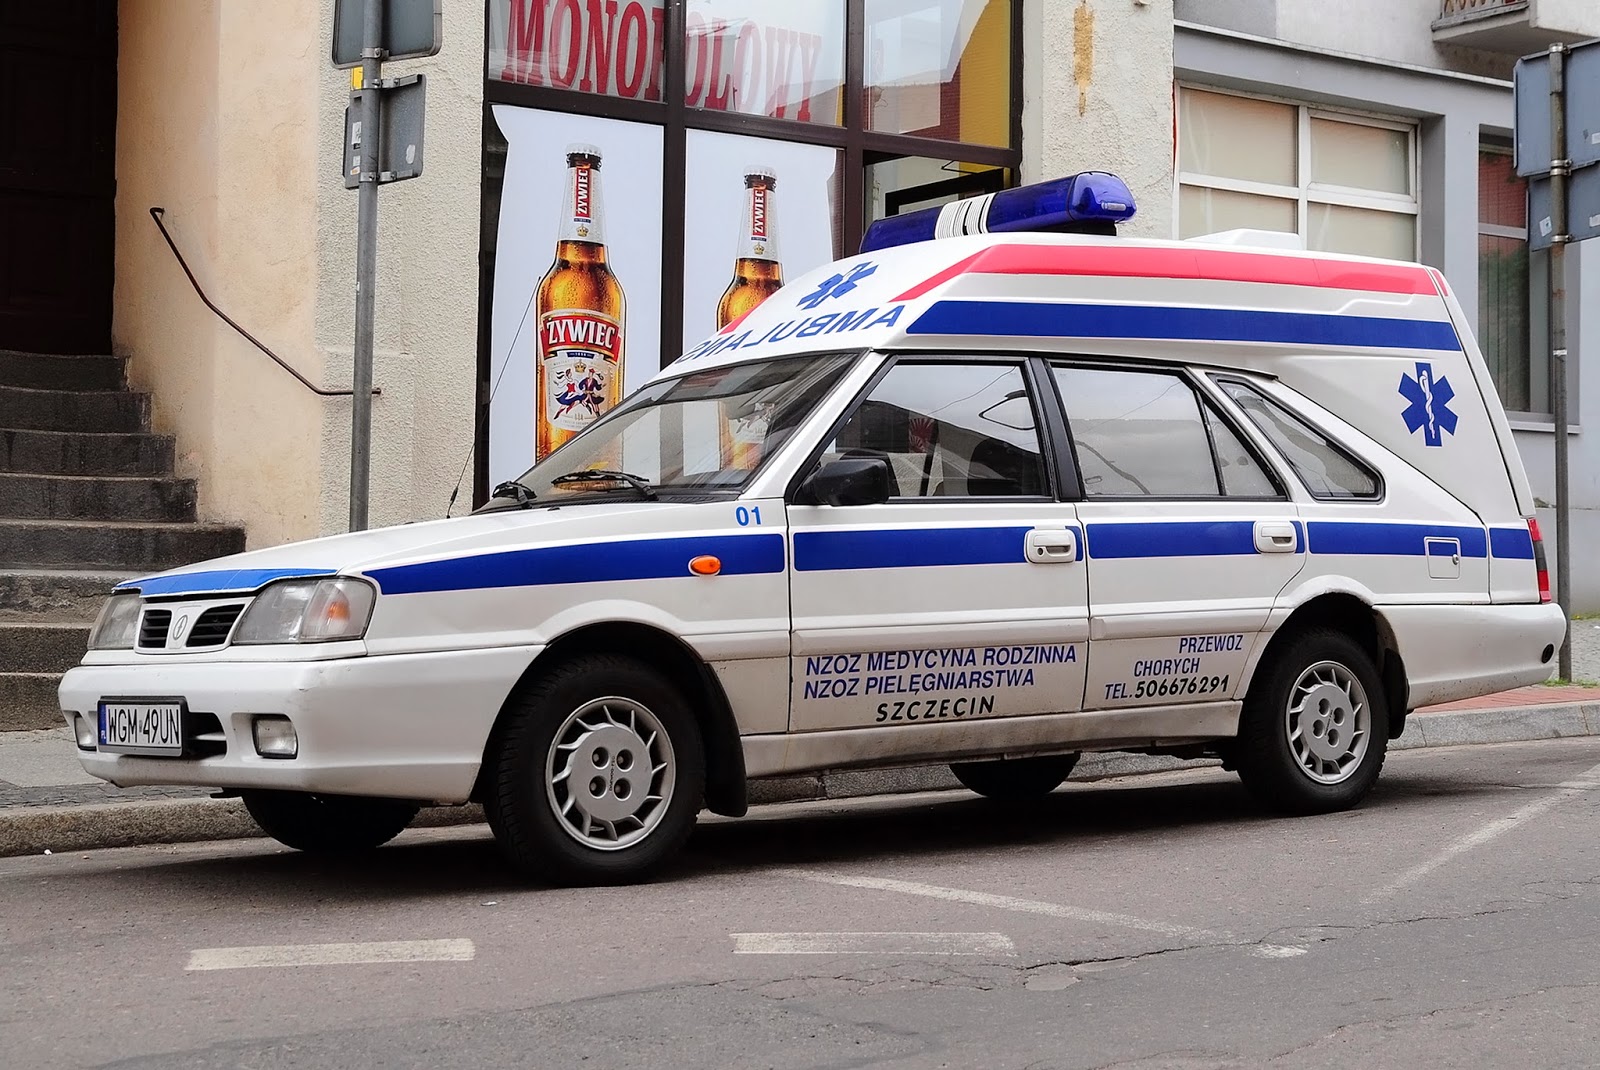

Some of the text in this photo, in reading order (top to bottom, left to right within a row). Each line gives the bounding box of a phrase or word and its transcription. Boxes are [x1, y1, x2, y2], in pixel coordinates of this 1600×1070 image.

[576, 169, 588, 215] ŻYWIEC
[752, 189, 764, 234] ŻYWIEC
[546, 317, 615, 349] ŻYWIEC
[735, 506, 761, 526] 01
[806, 645, 1076, 675] NZOZ MEDYCYNA RODZINNA
[1134, 657, 1200, 677] CHORYCH
[804, 669, 1034, 699] NZOZ PIELĘGNIARSTWA
[876, 696, 995, 722] SZCZECIN
[108, 709, 180, 744] WGM 49UN
